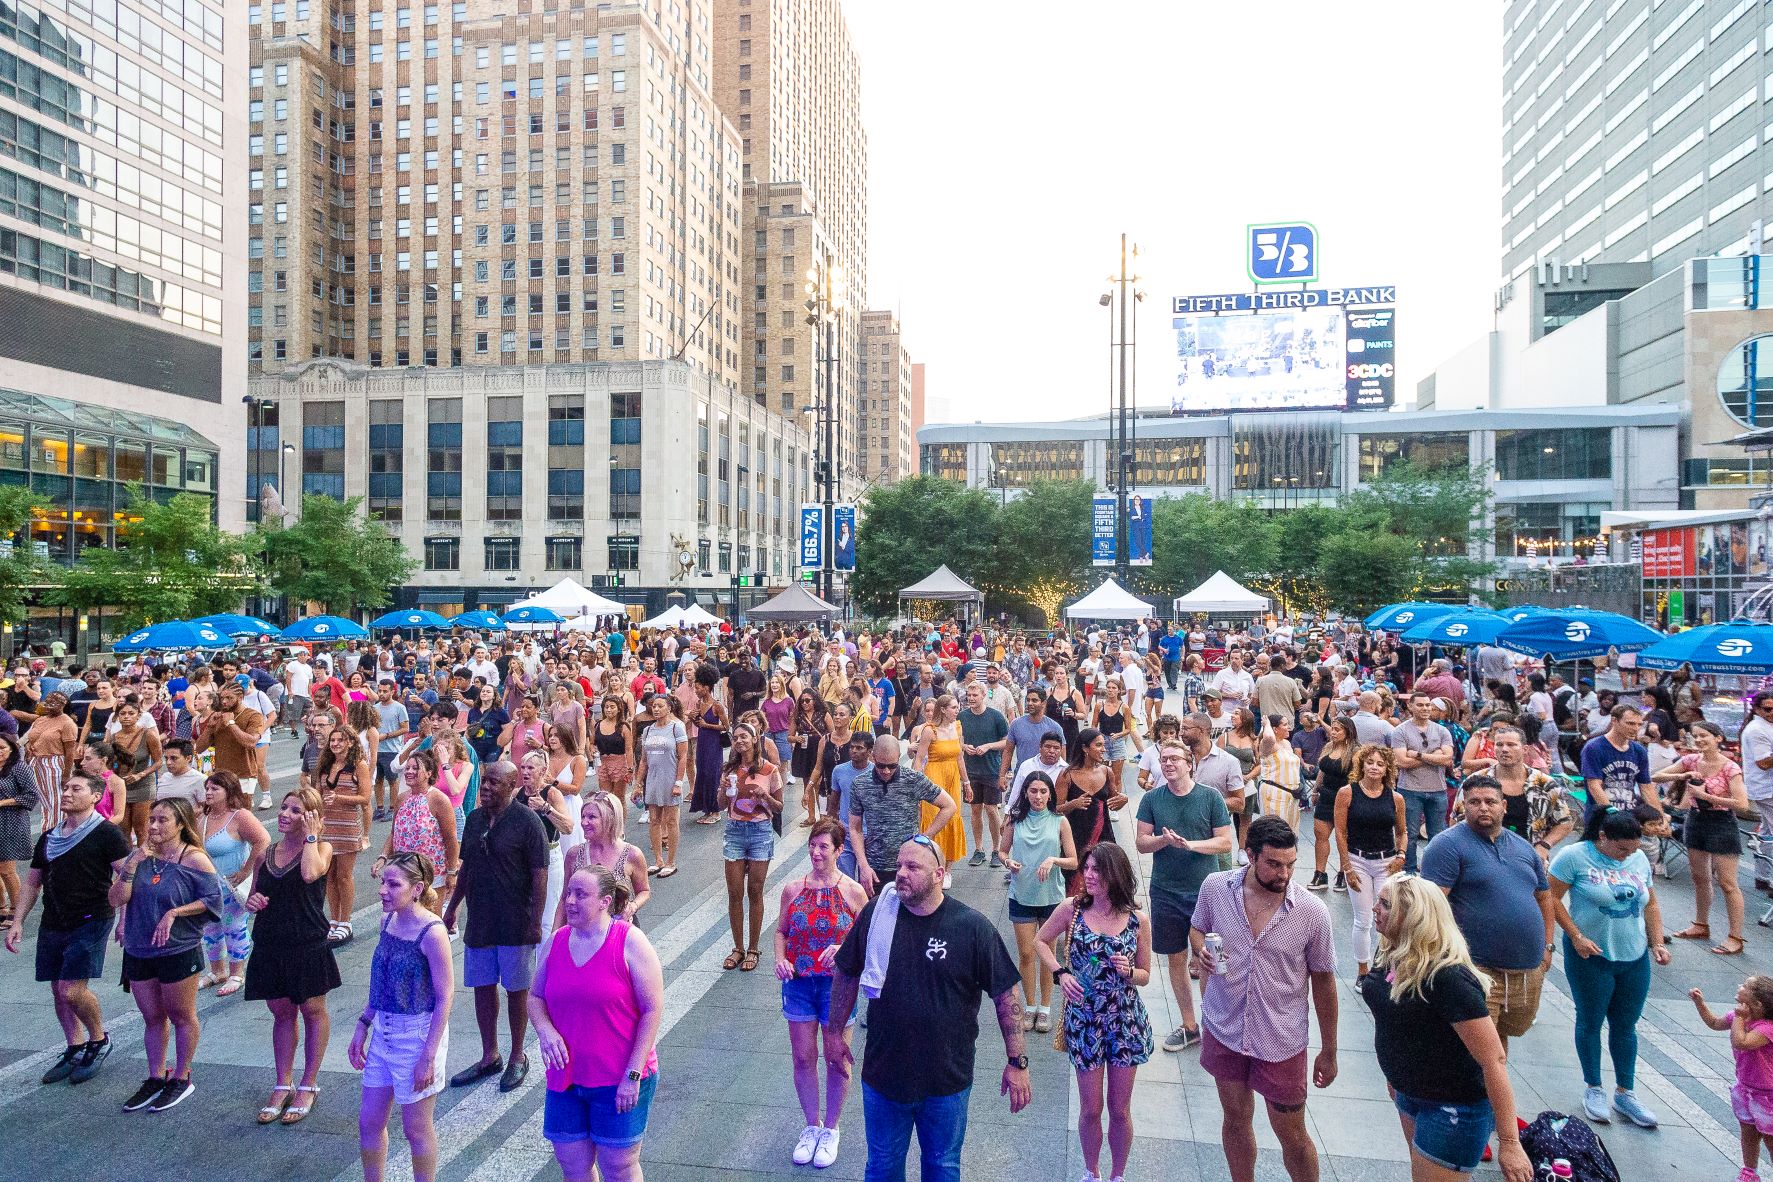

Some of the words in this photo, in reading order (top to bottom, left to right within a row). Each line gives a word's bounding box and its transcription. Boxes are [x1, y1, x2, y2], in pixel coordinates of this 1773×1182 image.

[1174, 295, 1237, 313] FIFTH
[1244, 292, 1319, 310] THIRD
[1326, 286, 1395, 306] BANK
[1366, 340, 1393, 349] PAINTS
[1347, 363, 1394, 379] 3CDC
[804, 511, 819, 564] 166.7%
[1701, 664, 1765, 673] strausstroy.com
[1602, 763, 1615, 775] DID
